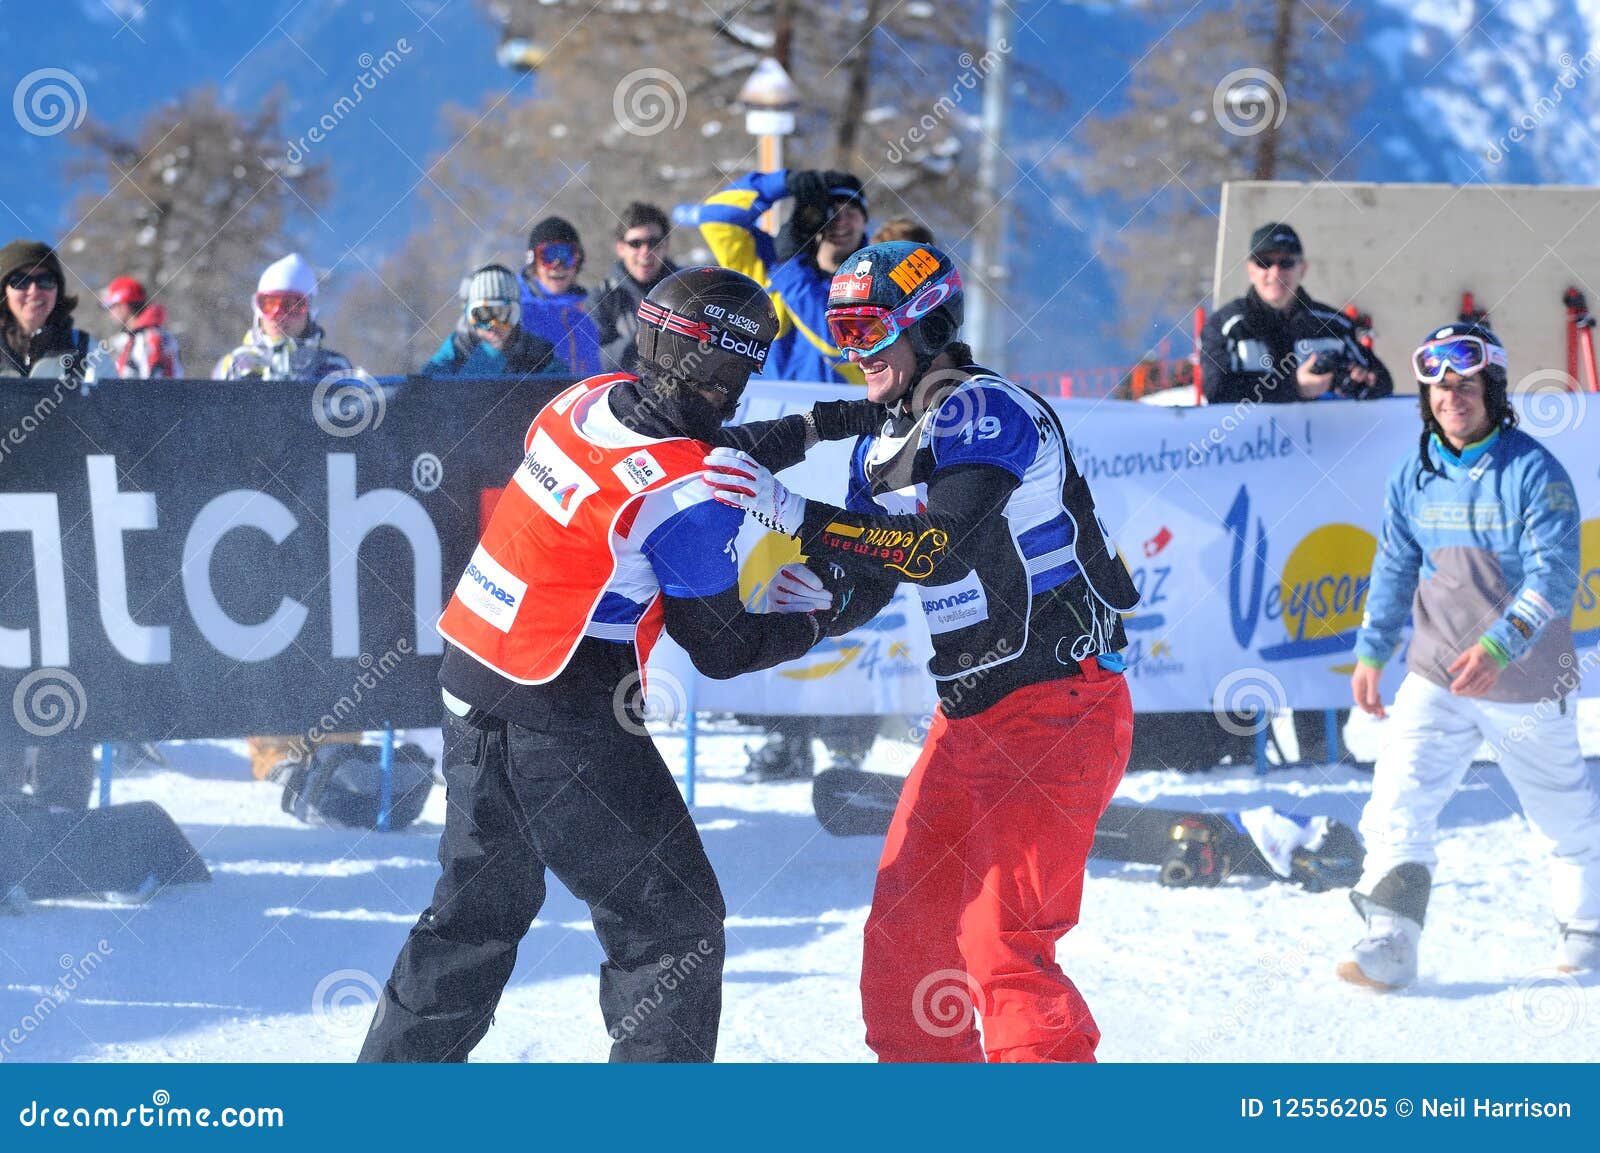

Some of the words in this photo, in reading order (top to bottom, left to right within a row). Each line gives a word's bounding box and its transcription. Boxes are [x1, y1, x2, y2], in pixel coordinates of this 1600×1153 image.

[721, 331, 768, 361] bollé
[957, 416, 1001, 445] 19
[641, 465, 653, 477] LG
[820, 533, 905, 563] Germany
